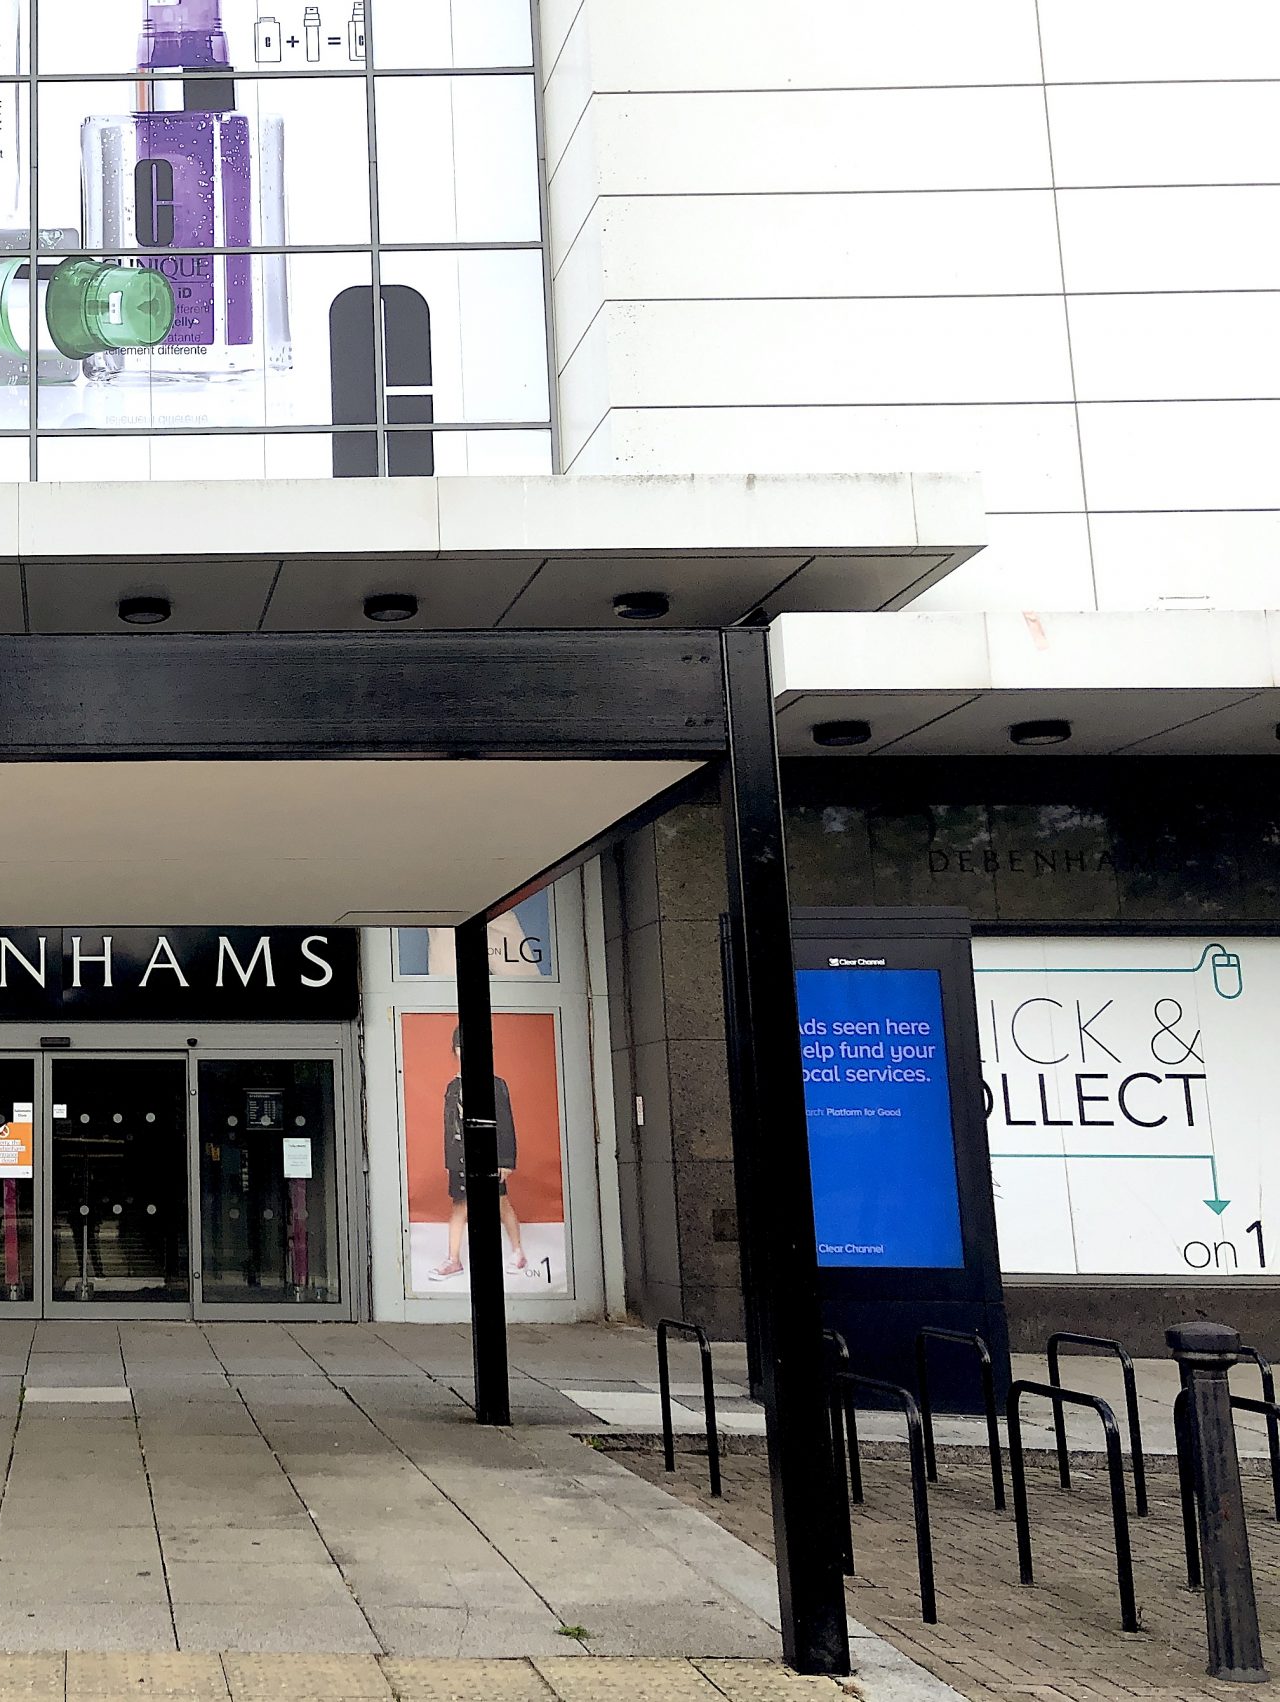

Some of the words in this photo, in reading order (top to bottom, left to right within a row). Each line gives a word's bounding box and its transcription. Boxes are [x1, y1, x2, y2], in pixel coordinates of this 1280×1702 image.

[178, 287, 192, 299] iD
[157, 345, 207, 355] différente
[928, 849, 1179, 873] DEBENHAM
[503, 936, 542, 963] LG
[839, 958, 857, 966] Clear
[857, 958, 885, 966] Channel
[832, 1022, 880, 1035] seen
[886, 1018, 930, 1035] here
[980, 998, 1122, 1065] ICK
[1151, 998, 1205, 1064] &
[839, 1041, 884, 1059] fund
[890, 1044, 936, 1063] your
[845, 1065, 931, 1082] services.
[980, 1072, 1207, 1127] LLECT
[826, 1108, 862, 1117] Platform
[864, 1108, 876, 1117] for
[877, 1108, 902, 1117] Good
[818, 1243, 843, 1254] Clear
[844, 1243, 884, 1254] Channel
[1183, 1241, 1238, 1268] on
[1245, 1220, 1266, 1268] 1
[540, 1256, 551, 1284] 1
